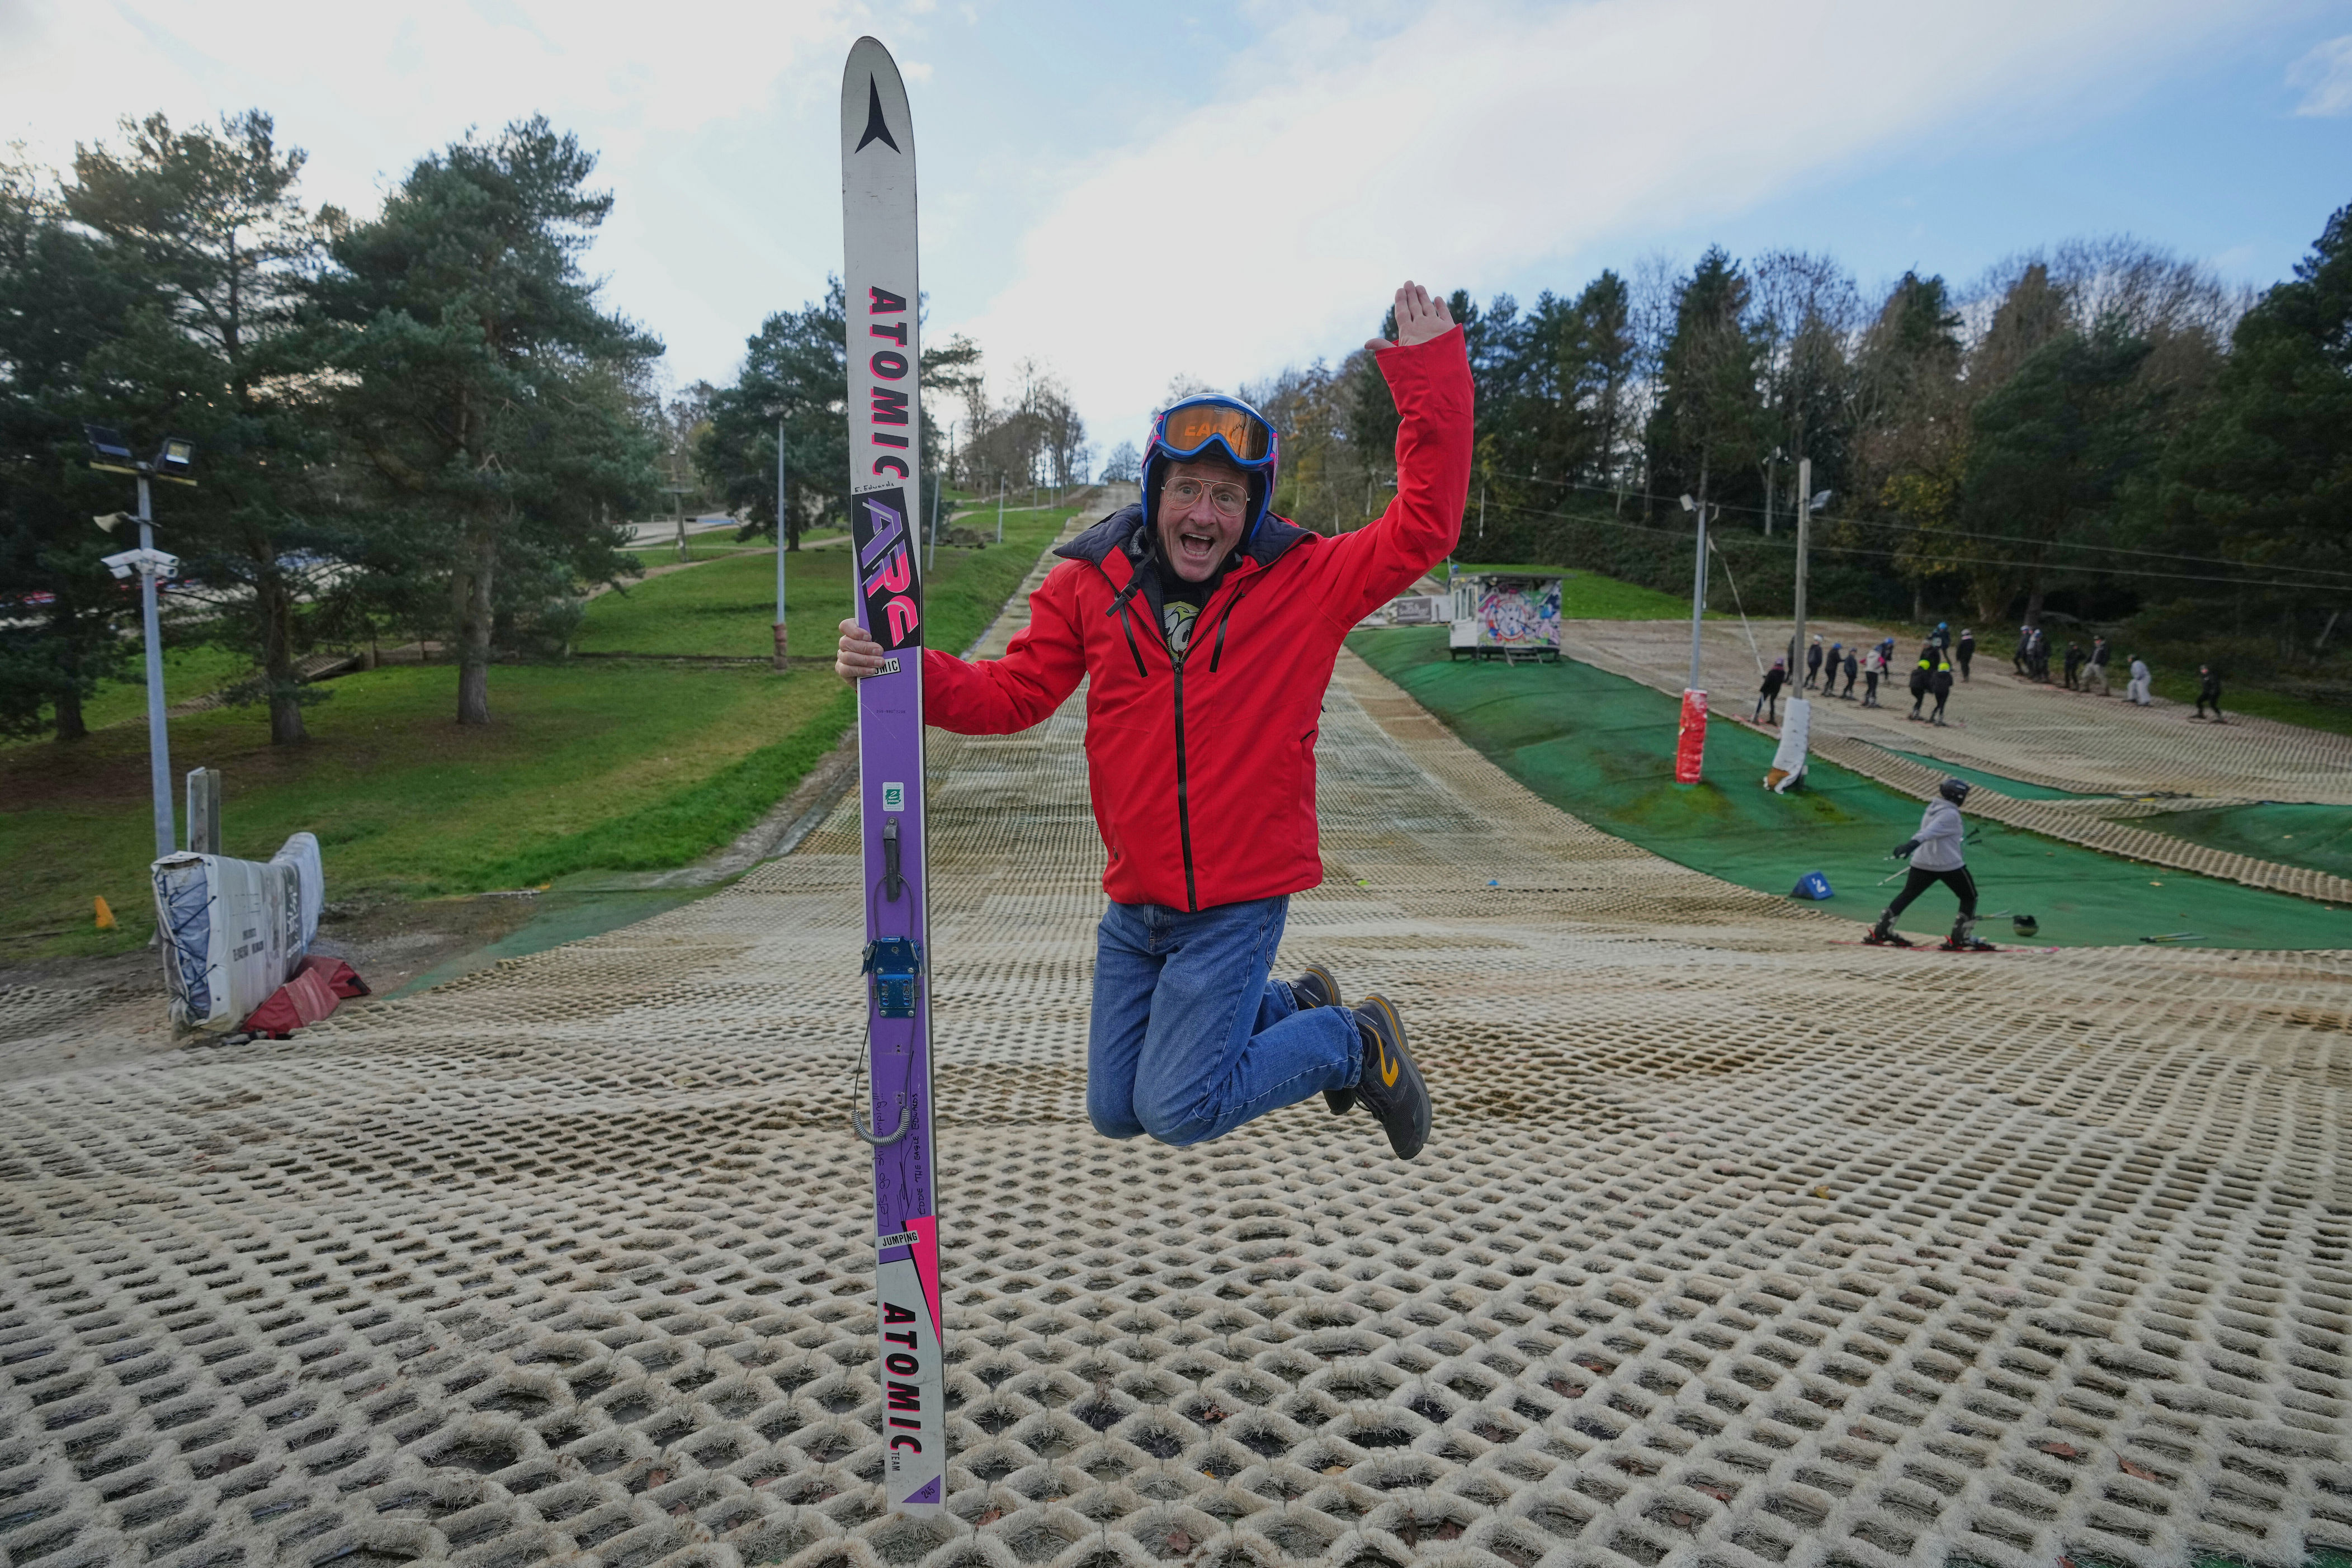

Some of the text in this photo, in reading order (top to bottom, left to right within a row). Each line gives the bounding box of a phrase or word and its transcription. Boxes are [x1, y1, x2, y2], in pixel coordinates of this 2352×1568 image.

[869, 286, 909, 480] ATOMIC
[861, 498, 919, 648] ARC
[875, 660, 898, 674] MIC
[888, 791, 899, 799] 2
[917, 1188, 925, 1215] EDDIE
[882, 1232, 918, 1246] JUMPING
[883, 1302, 922, 1454] ATOMIC
[891, 1452, 900, 1471] TEAM
[921, 1486, 935, 1499] 245
